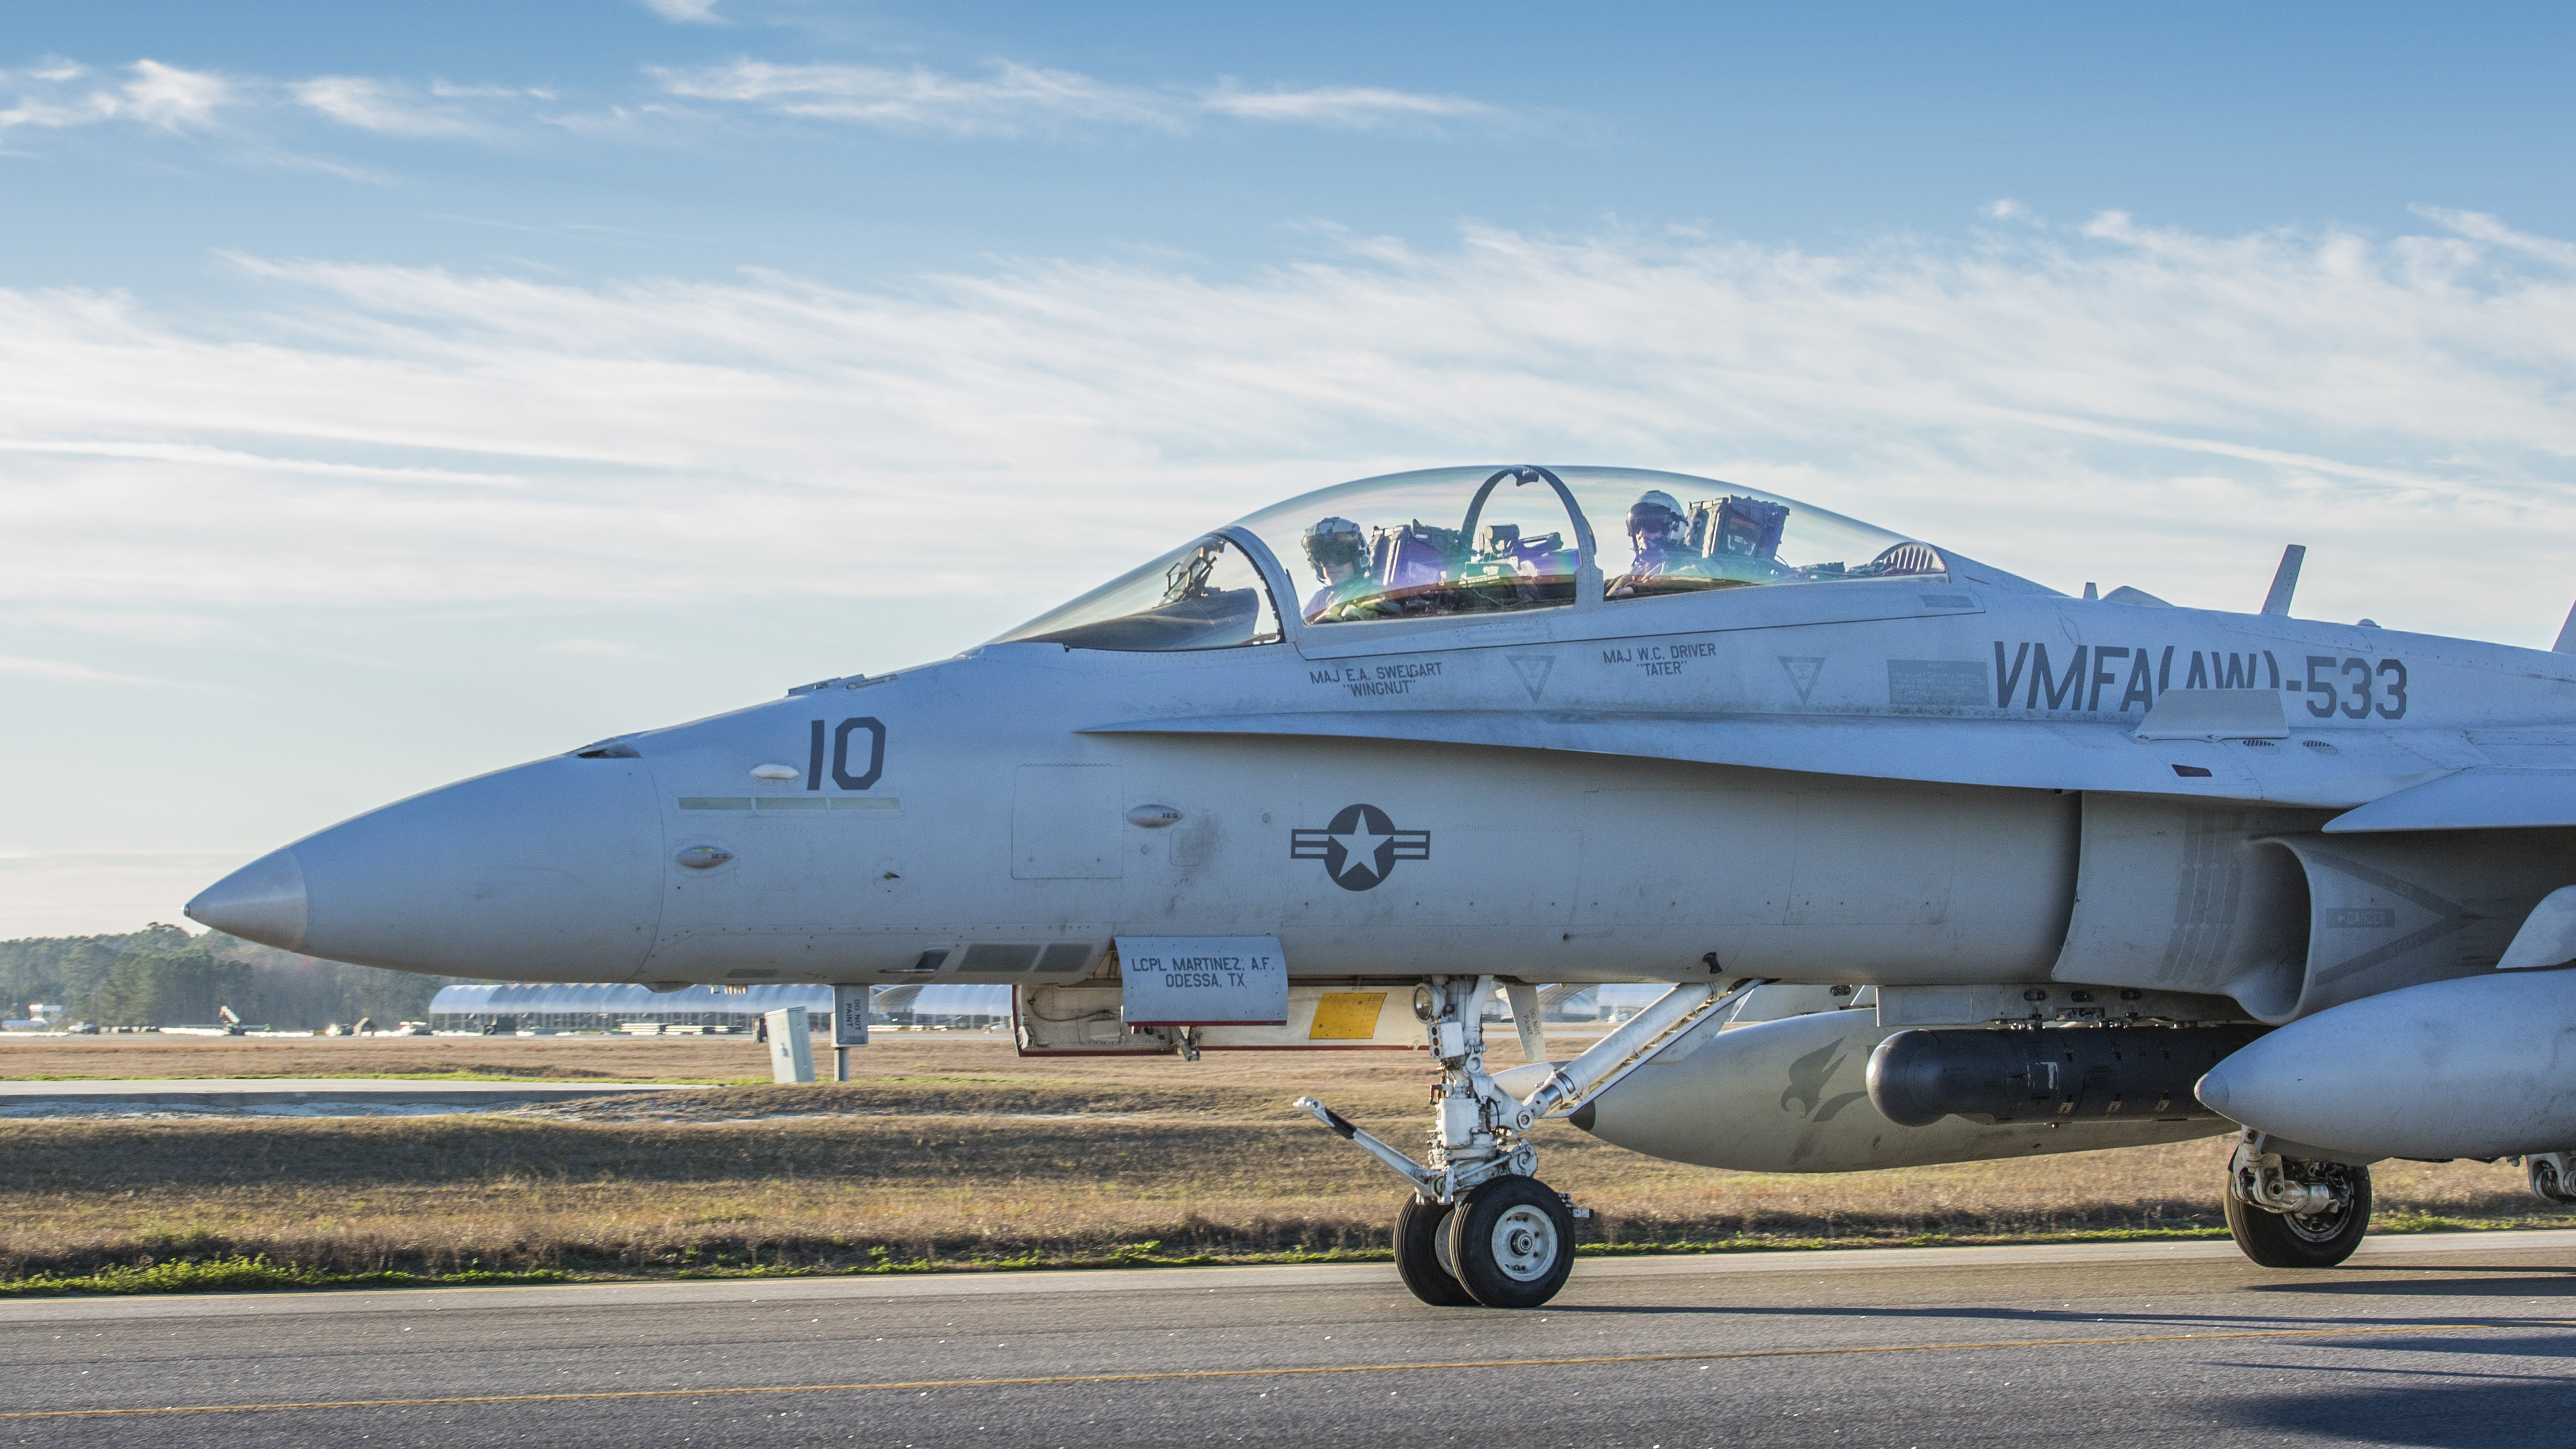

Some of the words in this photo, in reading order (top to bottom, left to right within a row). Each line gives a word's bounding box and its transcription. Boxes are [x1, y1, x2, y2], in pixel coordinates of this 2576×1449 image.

[1602, 649, 1632, 663] MAJ
[1637, 647, 1665, 661] W.C.
[1670, 643, 1716, 659] DRIVER
[1309, 670, 1340, 684] MAJ
[1345, 668, 1371, 682] E.A.
[1377, 662, 1442, 680] SWEIGART
[1636, 660, 1687, 676] "TATER"
[1343, 679, 1416, 697] "WINGNUT"
[807, 717, 886, 791] 10
[1131, 958, 1167, 971] LCPL
[1252, 957, 1275, 971] A.F.
[1166, 973, 1223, 988] ODESSA,
[854, 998, 861, 1011] DO
[1530, 1008, 1536, 1019] DO
[1523, 1014, 1533, 1035] PAINT
[1532, 1020, 1540, 1035] NOT
